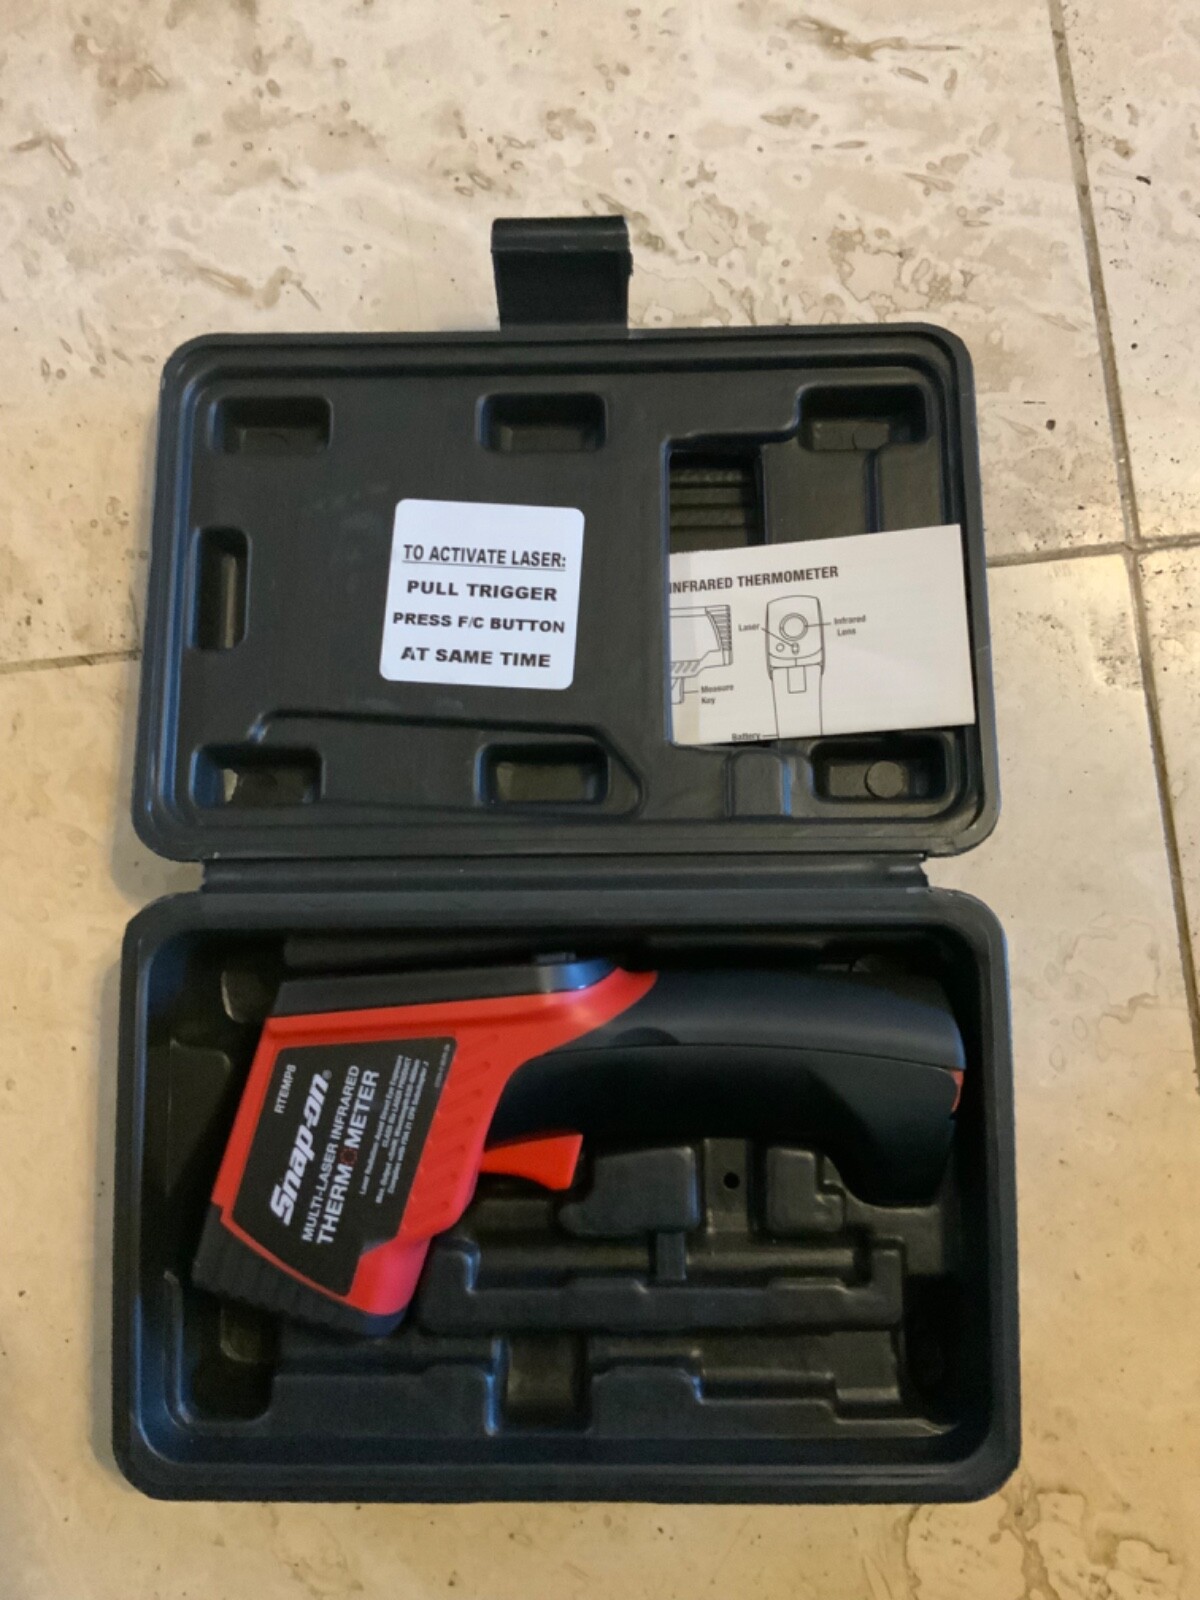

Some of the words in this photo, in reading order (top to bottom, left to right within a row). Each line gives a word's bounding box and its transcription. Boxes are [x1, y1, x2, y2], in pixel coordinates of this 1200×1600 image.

[403, 544, 425, 561] TO
[428, 545, 507, 566] ACTIVATE
[511, 550, 567, 569] LASER:
[406, 579, 460, 597] PULL
[466, 583, 558, 602] TRIGGER
[669, 577, 734, 594] INFRARED
[737, 565, 839, 588] THERMOMETER
[392, 612, 453, 628] PRESS
[457, 615, 485, 630] F/C
[489, 617, 566, 634] BUTTON
[737, 622, 760, 633] Laser
[833, 614, 867, 625] Infrared
[837, 627, 857, 637] Lens
[400, 646, 431, 661] AT
[434, 648, 494, 665] SAME
[499, 652, 551, 668] TIME
[700, 683, 735, 694] Measure
[700, 696, 716, 706] Key
[302, 1142, 339, 1243] MULTI-LASER
[331, 1065, 360, 1140] INFRARED
